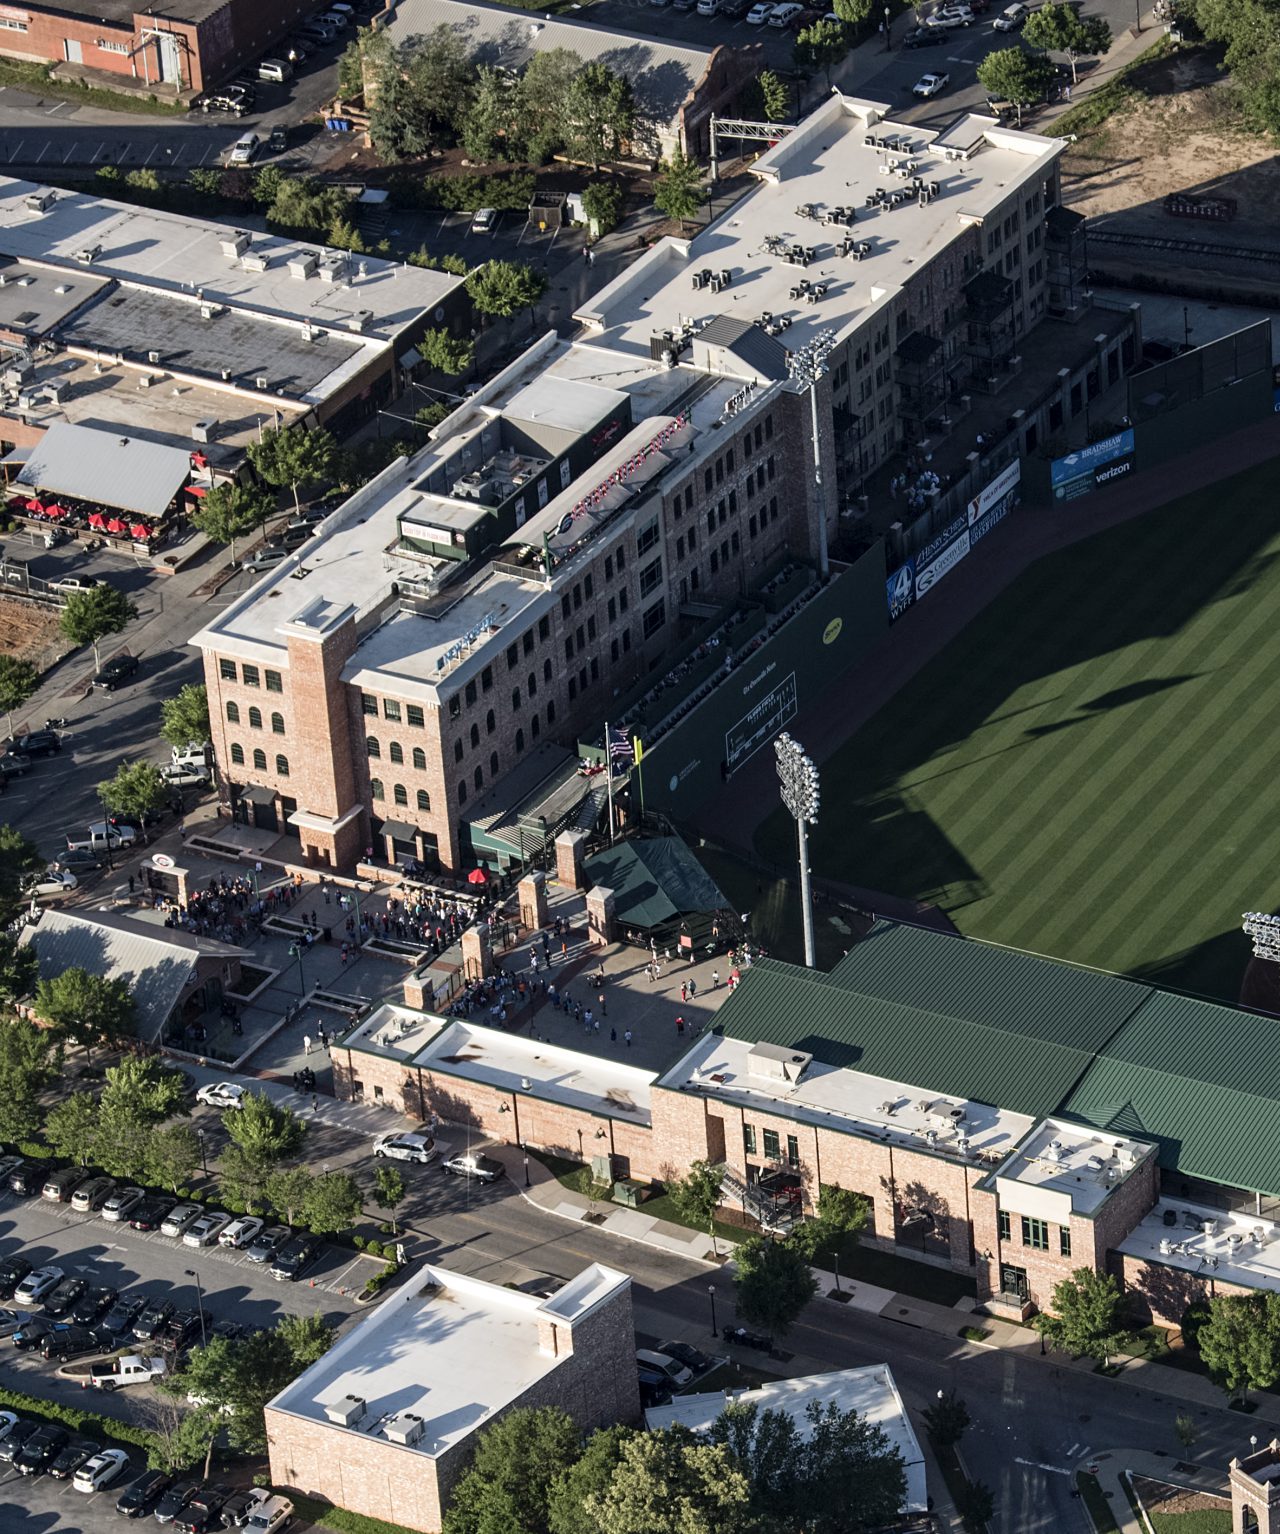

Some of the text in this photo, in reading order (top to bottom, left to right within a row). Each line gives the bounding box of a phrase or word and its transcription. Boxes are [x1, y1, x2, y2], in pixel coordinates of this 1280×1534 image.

[1081, 433, 1122, 459] BRADSHAW
[1095, 462, 1130, 483] verizon
[895, 567, 911, 597] 4
